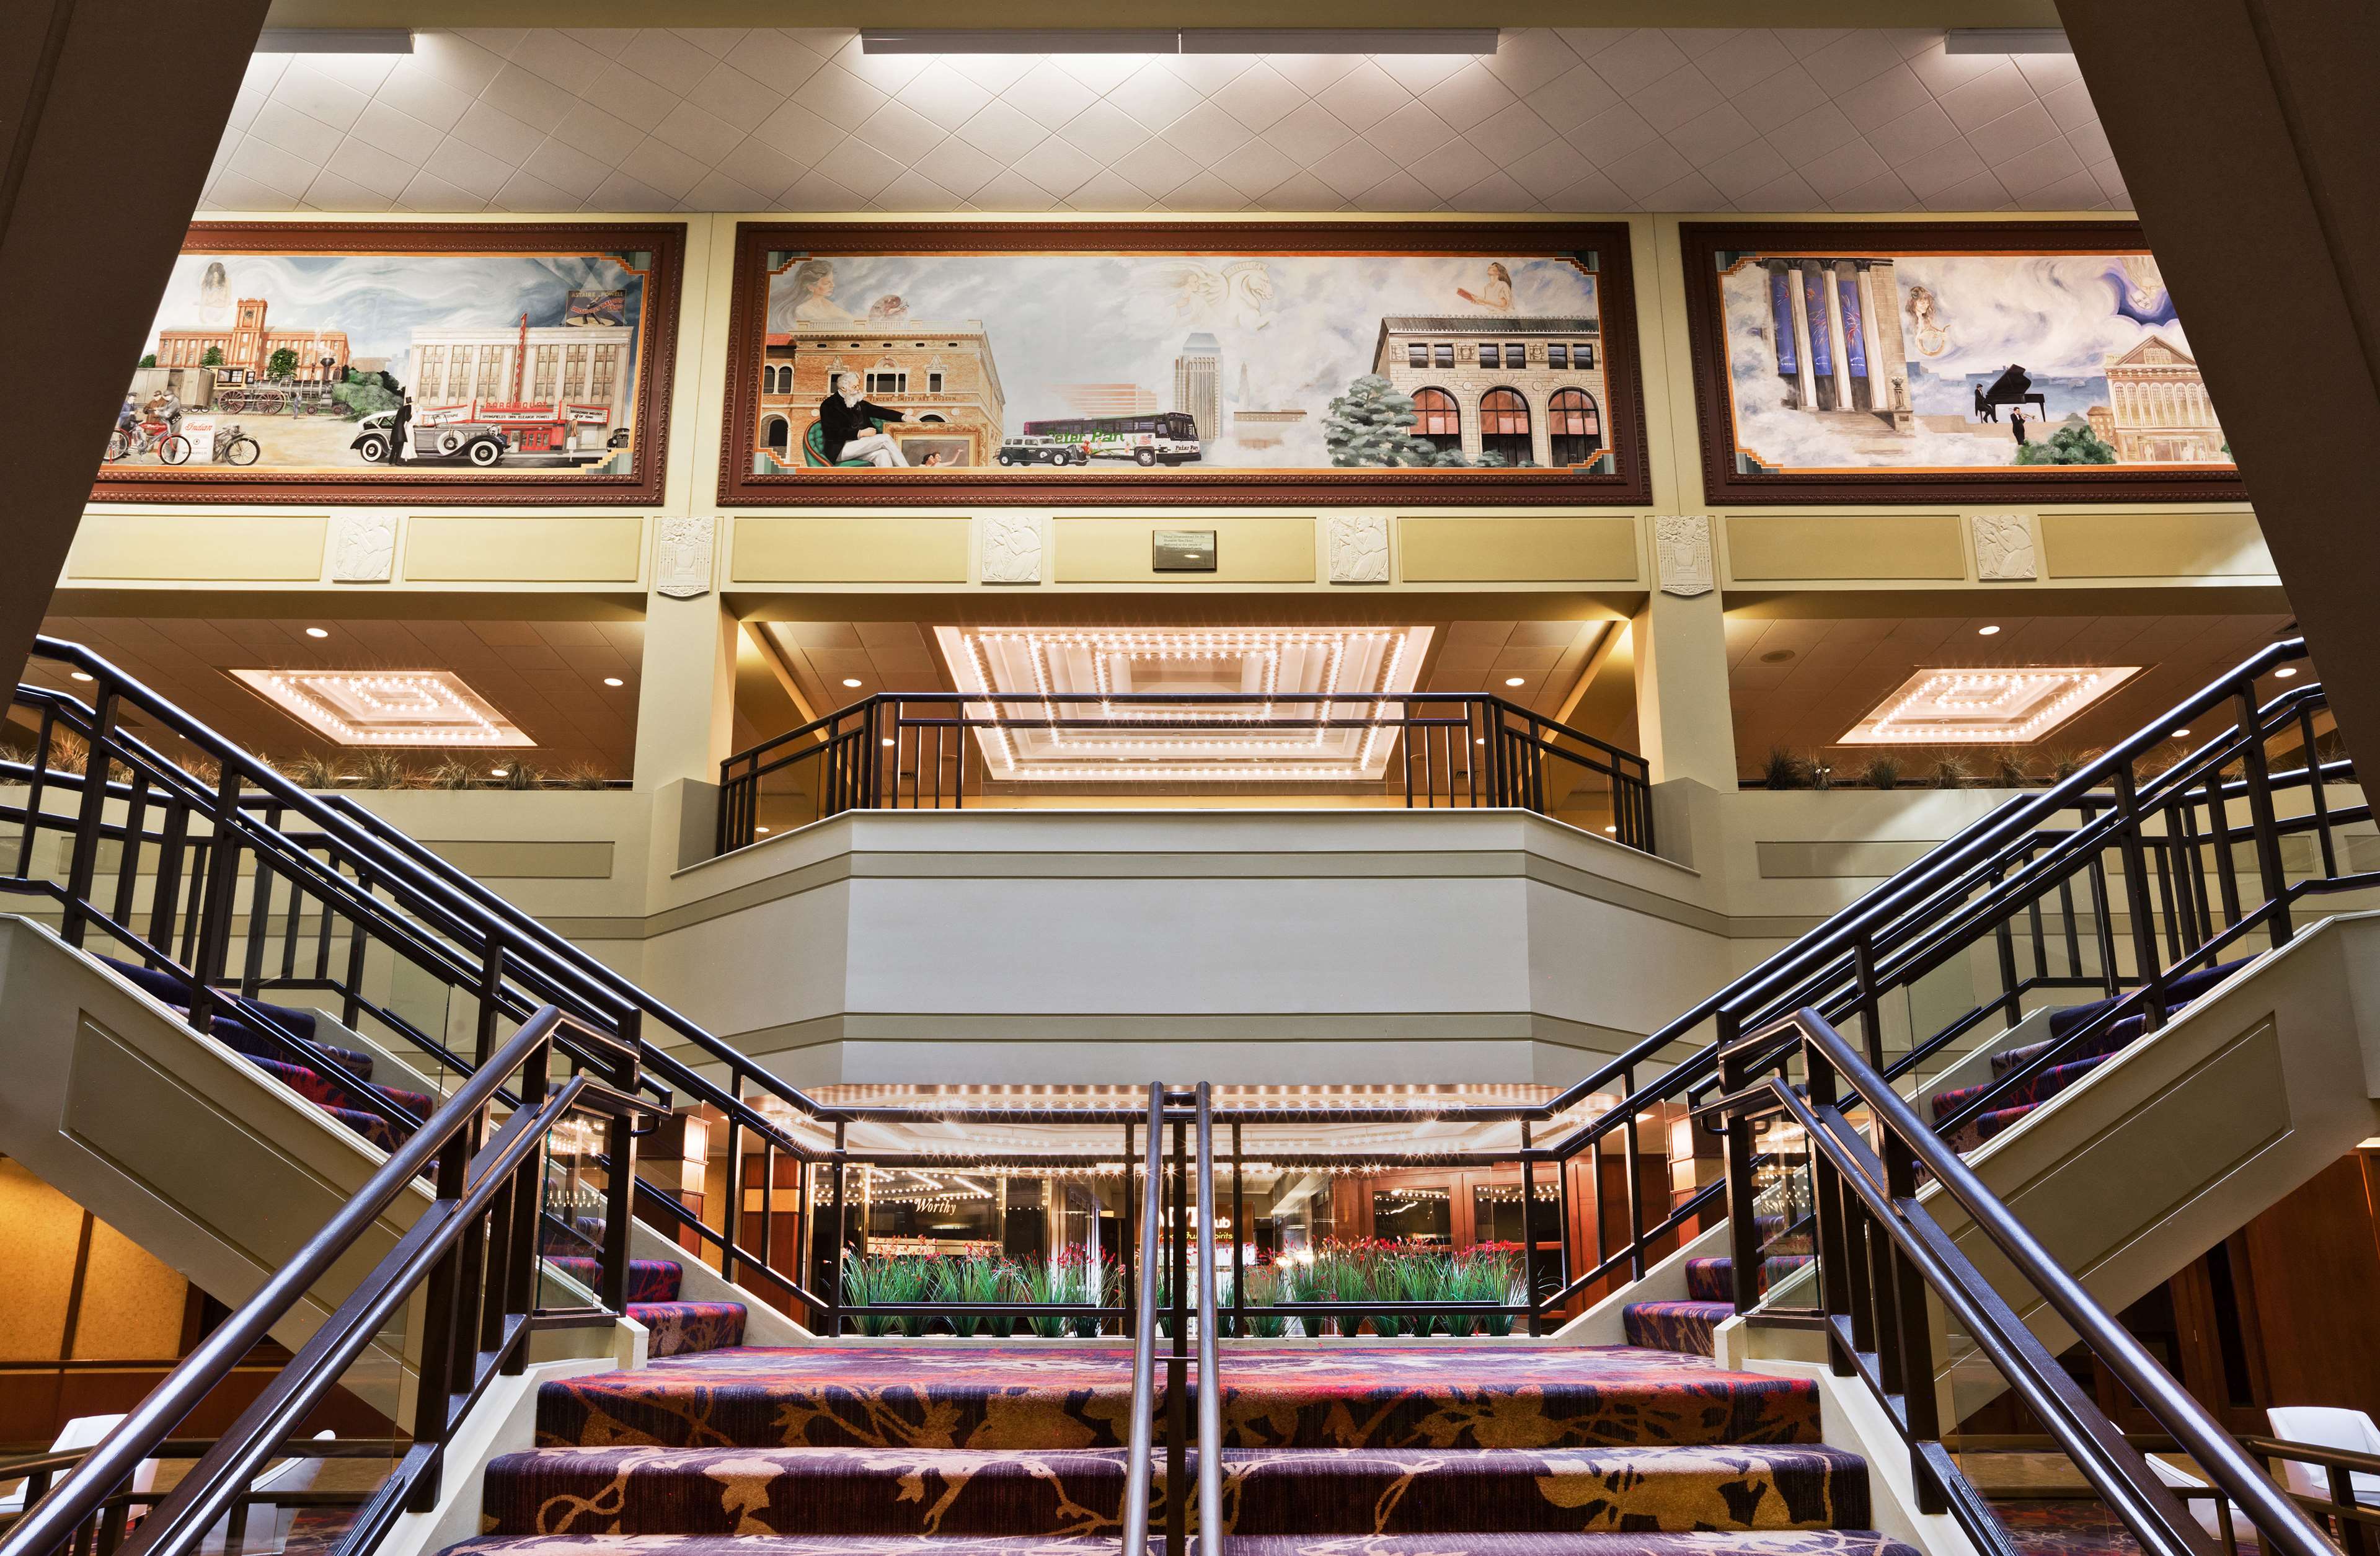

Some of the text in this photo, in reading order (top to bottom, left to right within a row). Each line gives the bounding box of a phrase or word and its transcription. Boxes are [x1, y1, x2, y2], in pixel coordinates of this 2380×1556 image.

[185, 422, 213, 431] Indian
[1046, 427, 1125, 444] Peter Pan
[914, 1198, 957, 1216] Worthy
[1214, 1217, 1231, 1228] ub
[1214, 1231, 1234, 1239] pirits
